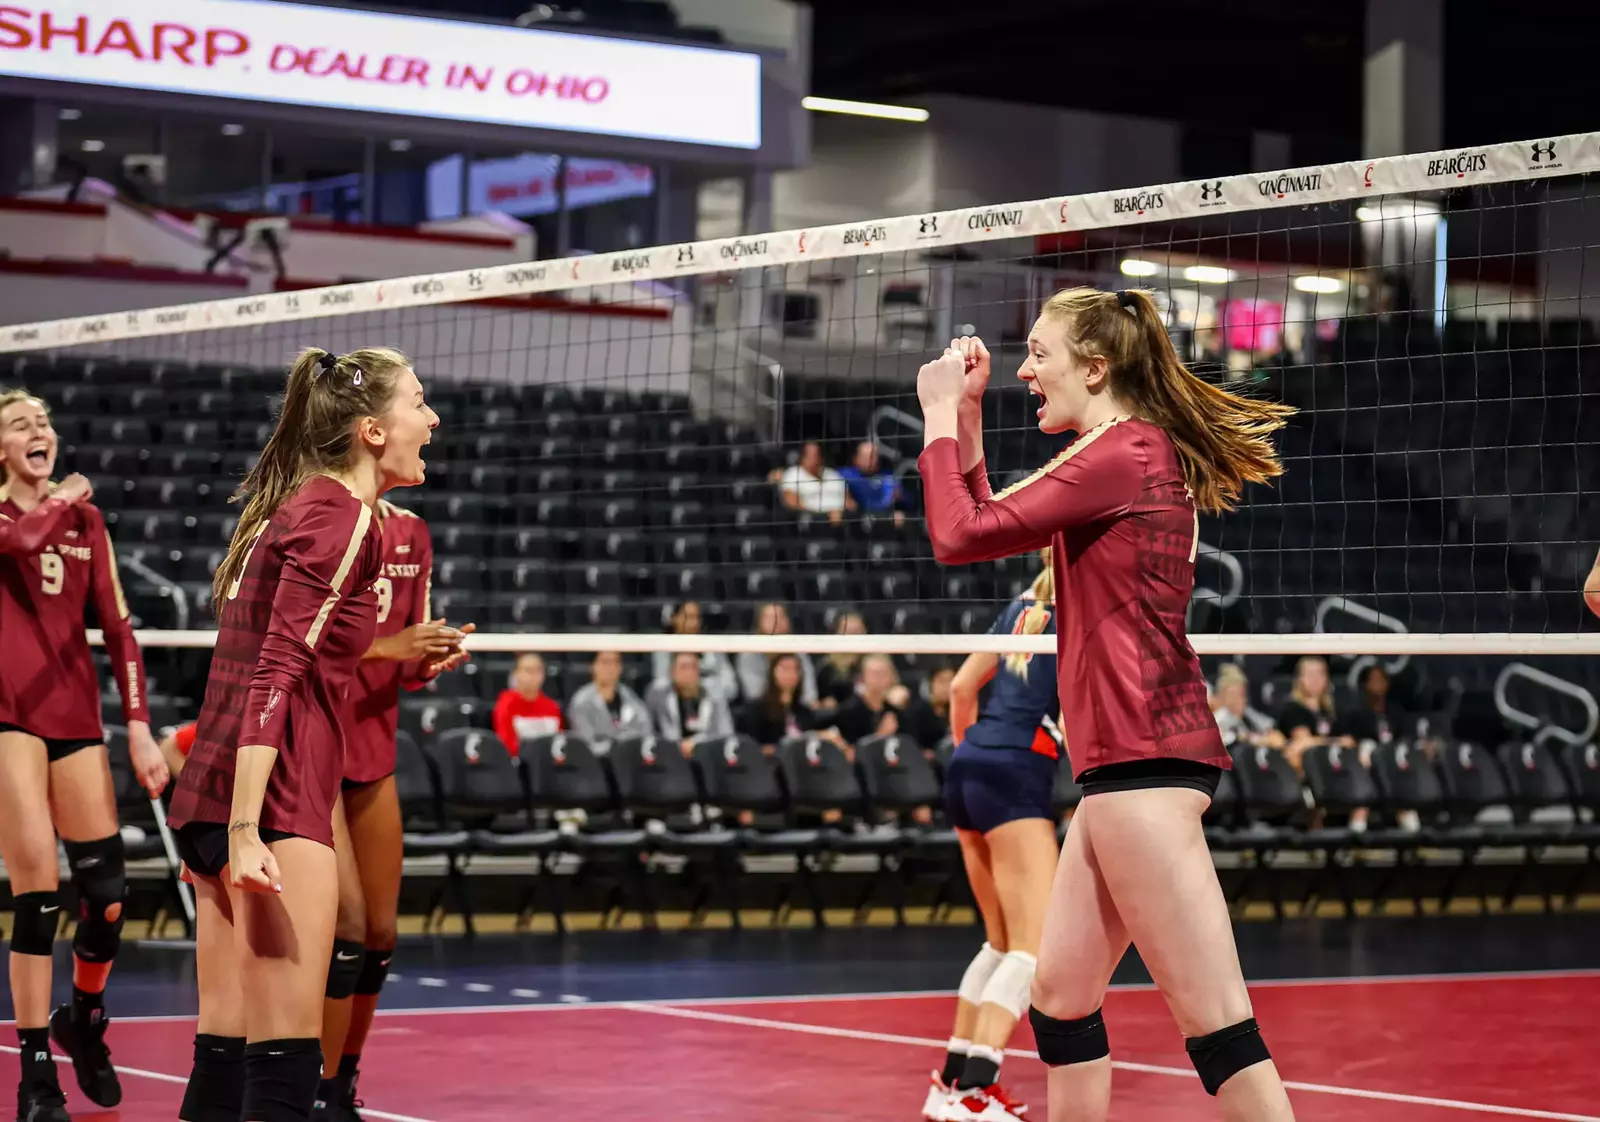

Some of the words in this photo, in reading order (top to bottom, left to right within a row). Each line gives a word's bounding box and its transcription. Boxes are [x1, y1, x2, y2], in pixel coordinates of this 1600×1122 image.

[0, 6, 250, 66] SHARP
[268, 44, 430, 87] DEALER
[445, 64, 494, 92] IN
[506, 68, 610, 104] OHIO
[843, 226, 887, 245] BEARCATS
[968, 210, 1023, 230] CINCINNATI
[1114, 192, 1164, 214] BEARCATS
[1258, 174, 1322, 196] CINCINNATI
[1427, 153, 1487, 177] BEARCATS
[39, 552, 64, 595] 9
